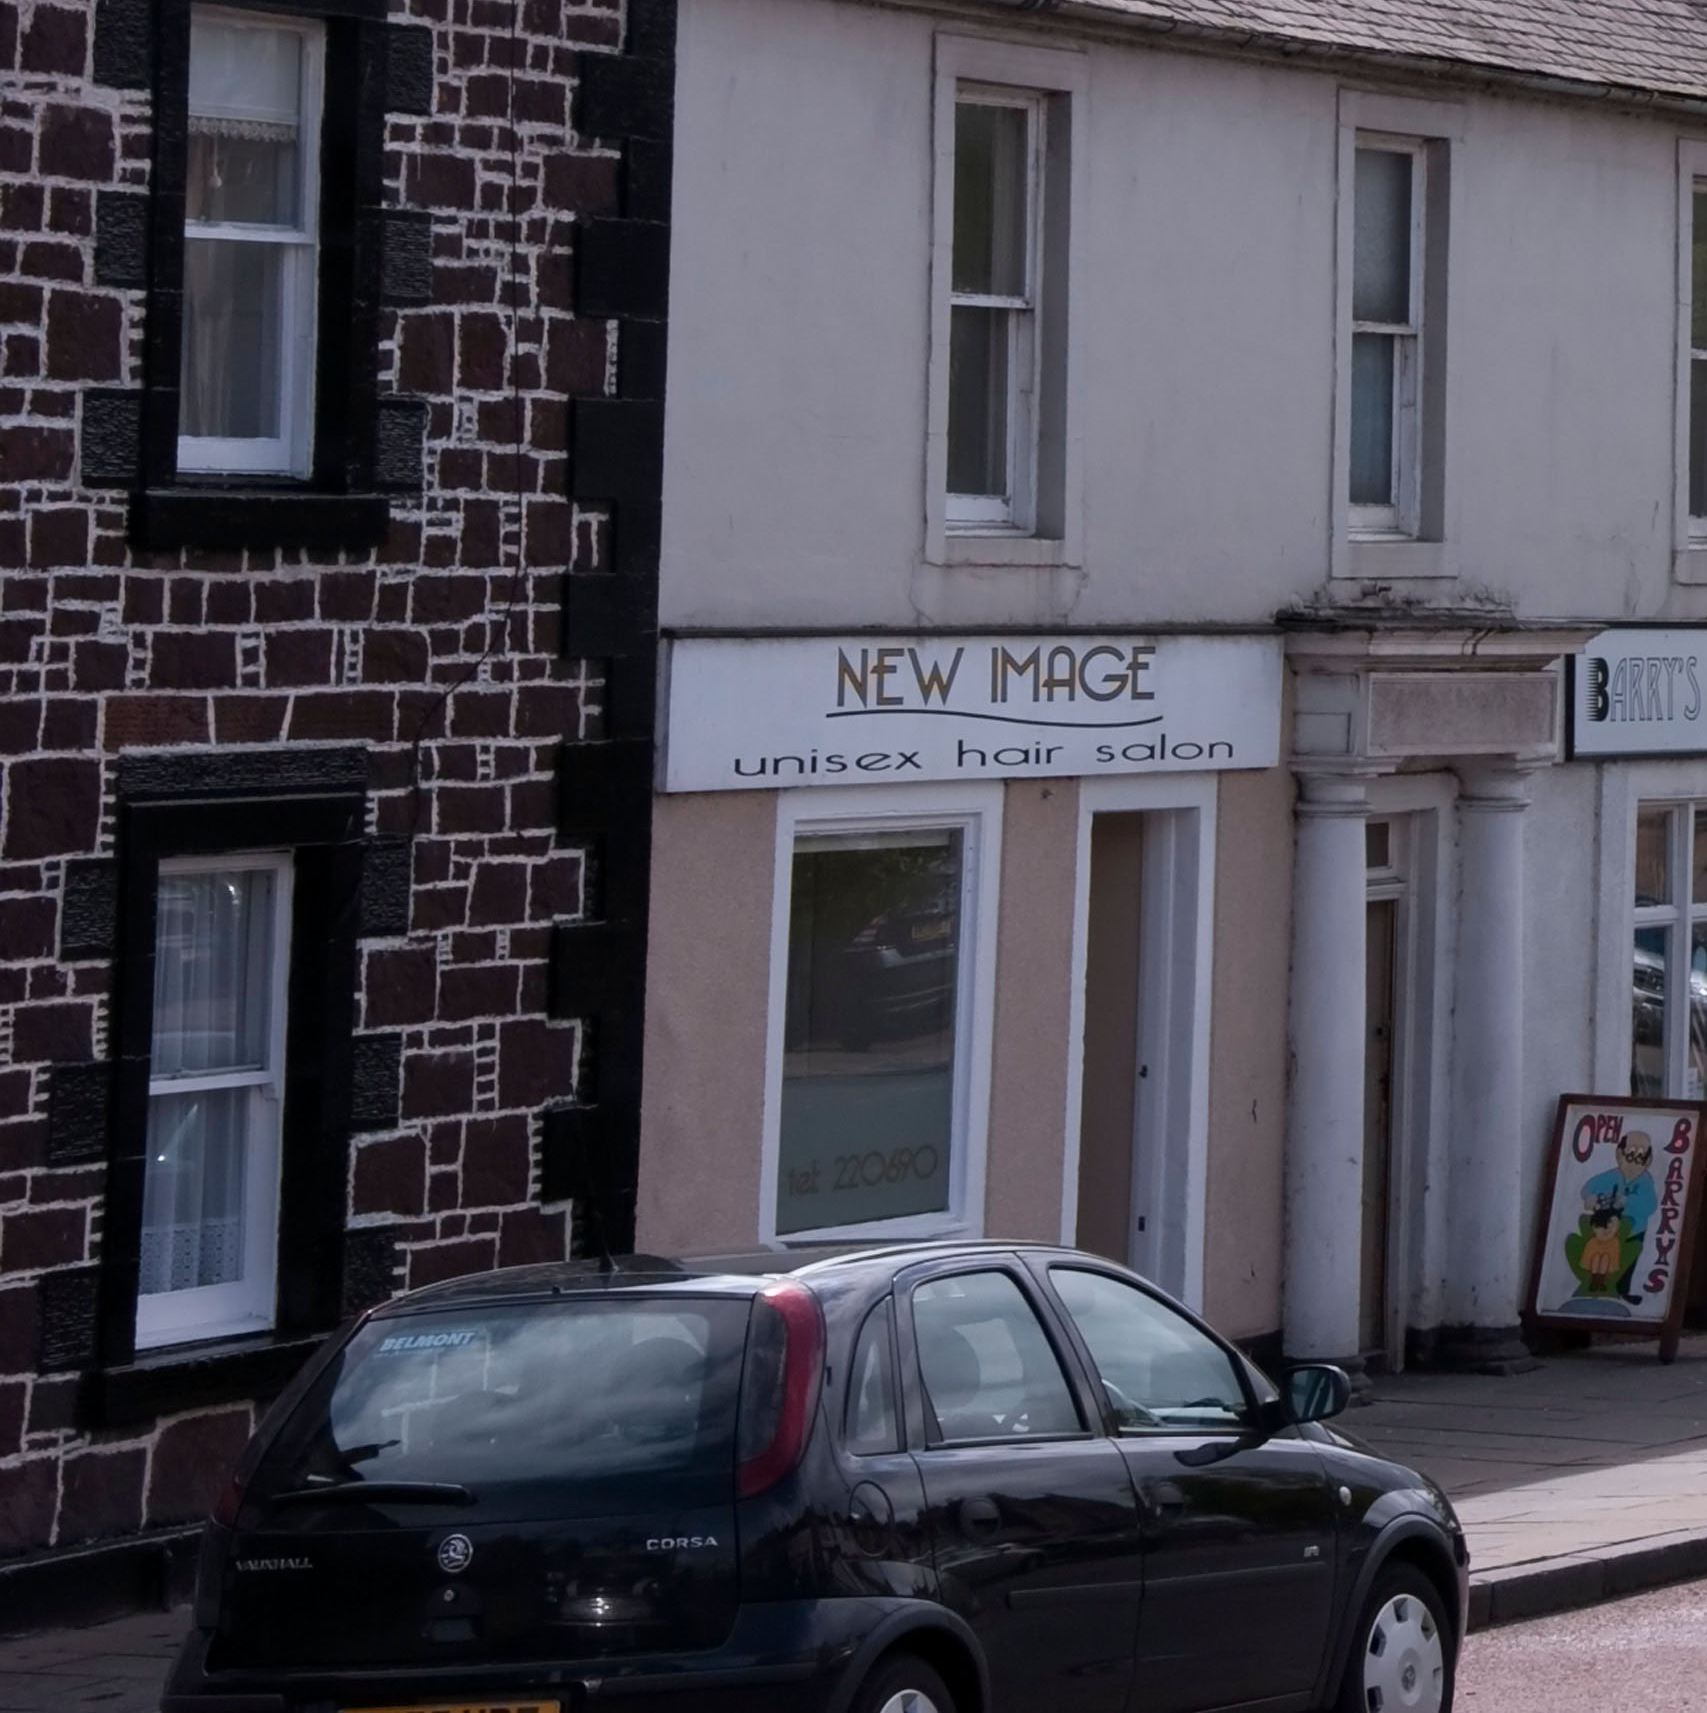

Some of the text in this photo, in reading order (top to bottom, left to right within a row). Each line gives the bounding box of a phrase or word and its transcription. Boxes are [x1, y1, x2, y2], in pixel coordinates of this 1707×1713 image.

[836, 644, 1157, 707] NEW IMAGE
[1587, 655, 1701, 723] BARRY'S
[734, 734, 1234, 777] unisex hair salon
[1572, 1113, 1624, 1163] OPEN
[1643, 1117, 1692, 1294] BARRYS
[379, 1332, 477, 1351] BELMONT
[235, 1557, 314, 1571] VAUXHALL
[646, 1536, 719, 1551] CORSA
